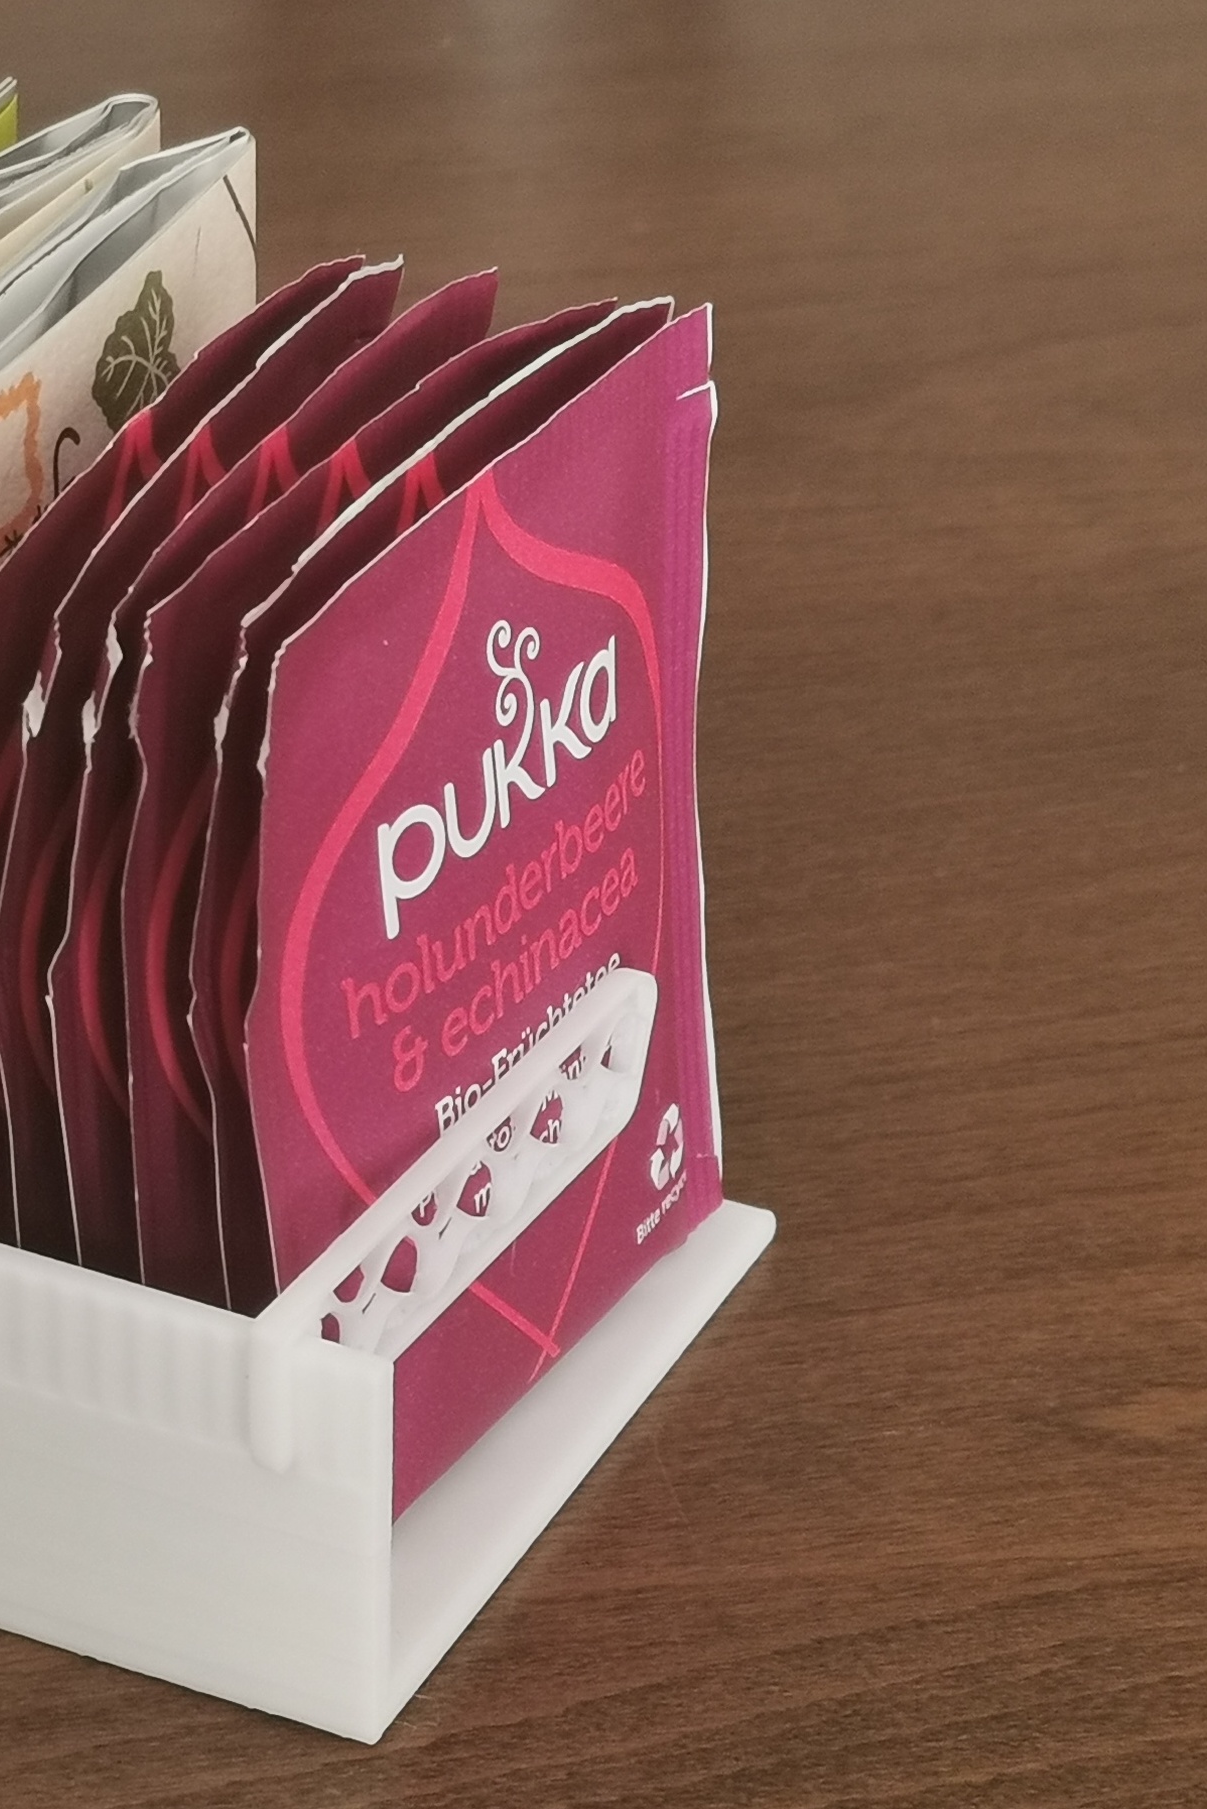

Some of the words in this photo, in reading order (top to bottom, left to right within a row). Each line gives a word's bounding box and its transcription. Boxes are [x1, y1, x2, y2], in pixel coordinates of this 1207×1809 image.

[340, 749, 646, 1039] holunderbeere
[377, 620, 617, 940] pukka
[394, 1024, 428, 1093] &
[440, 847, 639, 1057] echinacea
[636, 1207, 661, 1246] Bitte
